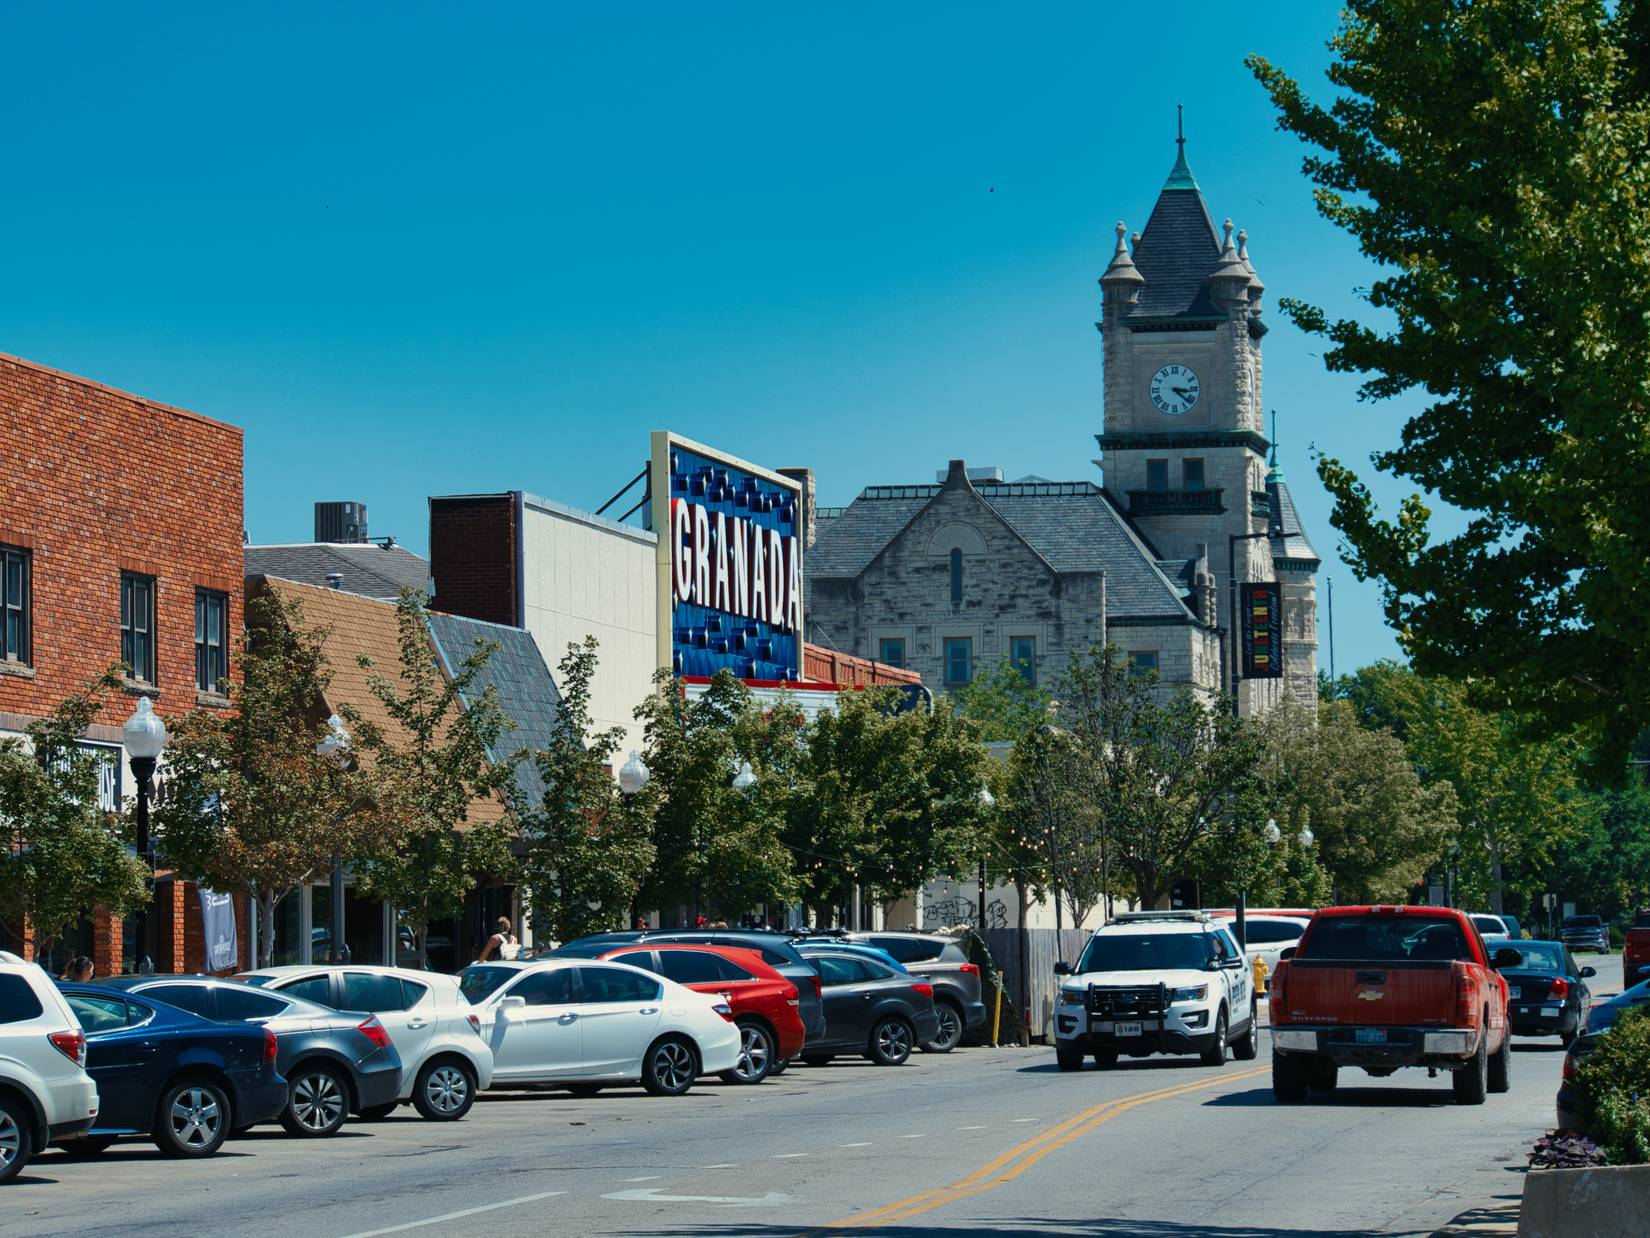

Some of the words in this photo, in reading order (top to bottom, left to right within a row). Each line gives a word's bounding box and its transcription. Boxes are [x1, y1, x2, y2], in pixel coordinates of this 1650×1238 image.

[676, 498, 800, 631] GRANADA
[1253, 591, 1269, 672] JUNETEENTH
[1269, 591, 1279, 630] Freedom!
[1270, 632, 1280, 671] Celebrate
